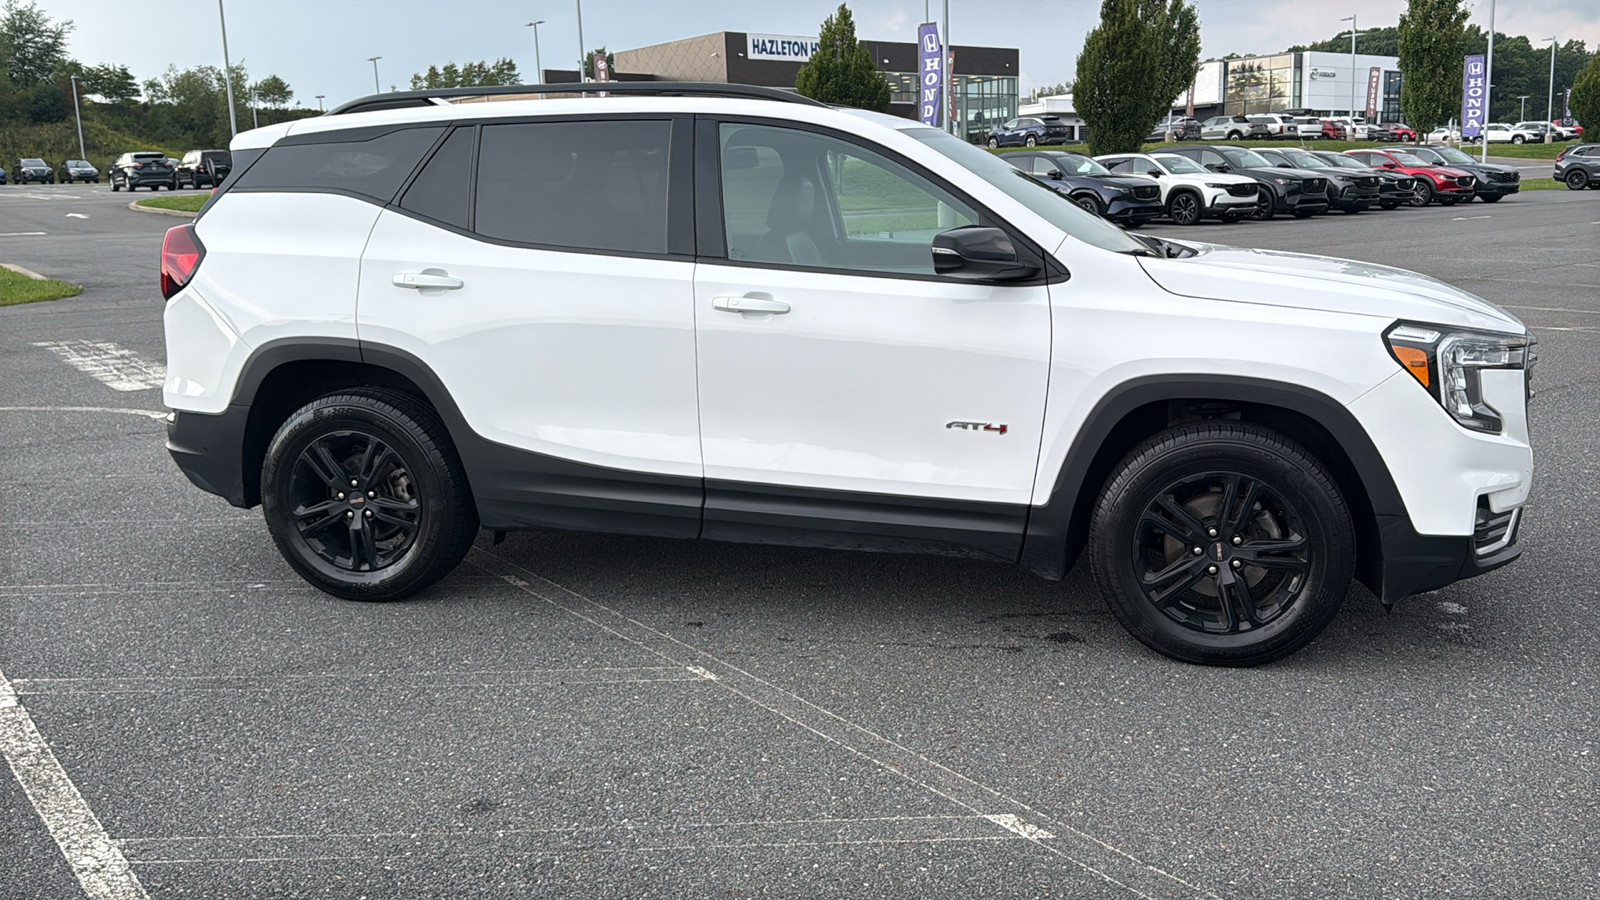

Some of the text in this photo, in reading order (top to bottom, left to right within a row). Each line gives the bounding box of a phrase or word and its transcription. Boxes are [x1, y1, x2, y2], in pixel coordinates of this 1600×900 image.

[752, 38, 808, 57] HAZLETON
[1466, 77, 1484, 128] HONDA
[945, 421, 1008, 435] AT4
